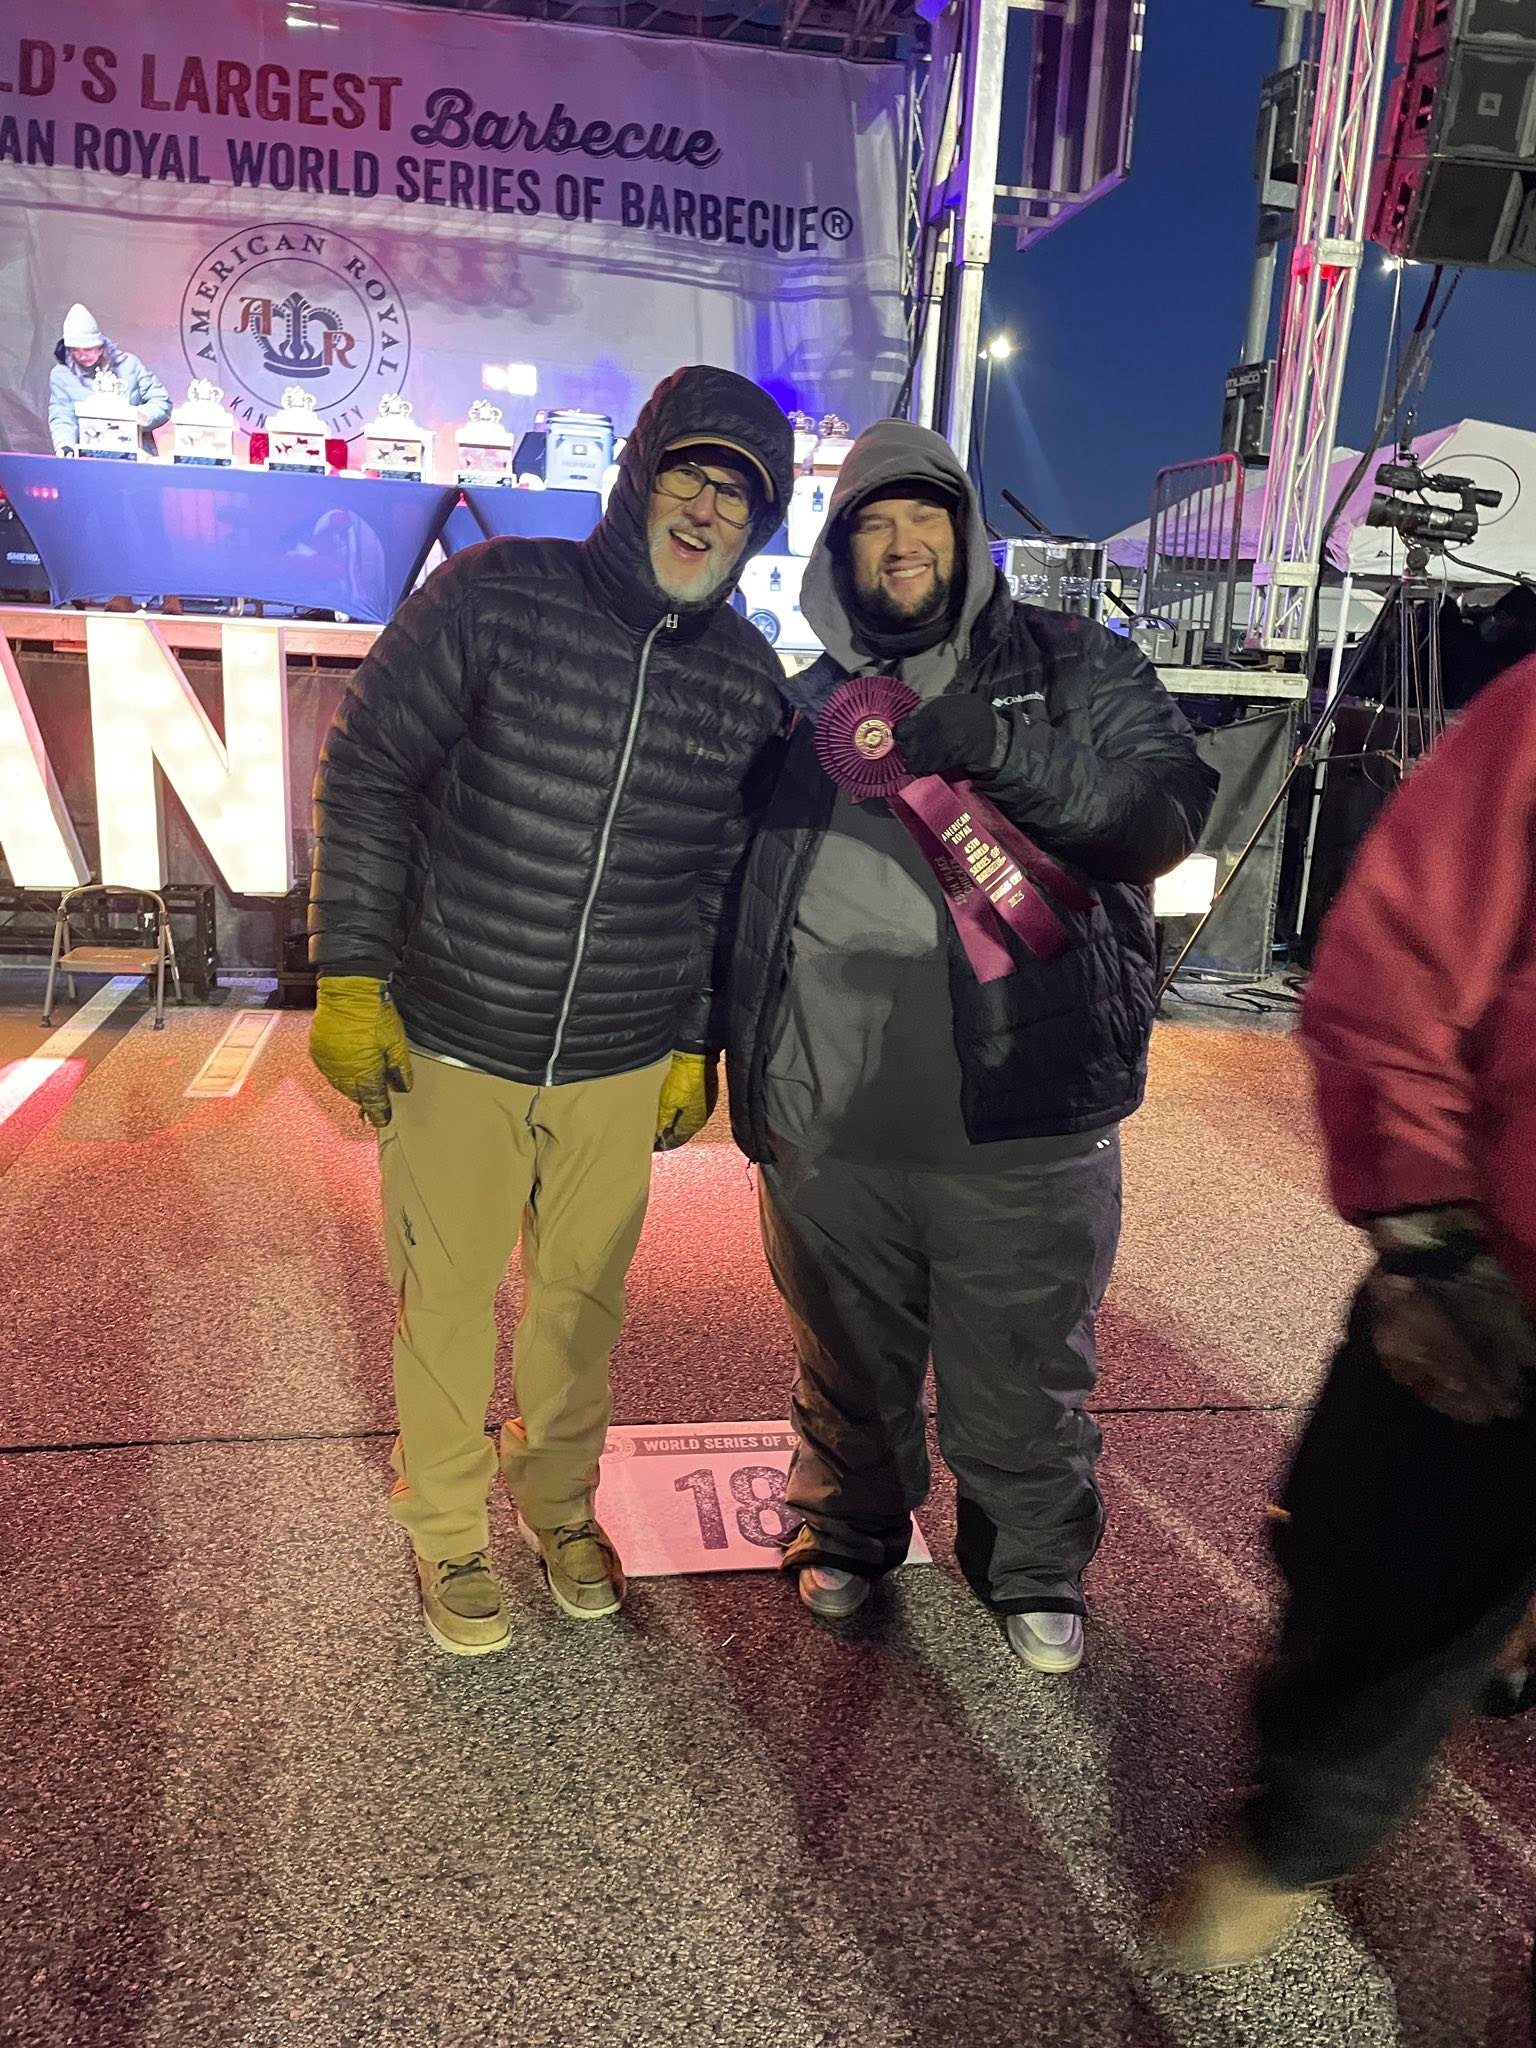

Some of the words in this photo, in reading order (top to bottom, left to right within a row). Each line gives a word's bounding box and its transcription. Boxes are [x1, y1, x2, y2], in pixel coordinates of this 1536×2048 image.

[0, 38, 118, 105] D'S
[141, 54, 403, 131] LARGEST
[410, 87, 724, 170] Barbecue
[75, 122, 210, 184] ROYAL
[227, 138, 379, 199] WORLD
[395, 155, 541, 216] SERIES
[556, 173, 604, 224] OF
[190, 233, 326, 363] AMERICAN
[344, 255, 400, 377] ROYAL
[229, 396, 267, 429] KAN
[326, 405, 363, 432] ITY
[941, 812, 971, 842] AMERICAN
[951, 824, 973, 845] ROYAL
[967, 843, 990, 864] WORLD
[644, 1438, 700, 1452] WORLD
[704, 1436, 759, 1449] SERIES
[762, 1435, 782, 1447] OF
